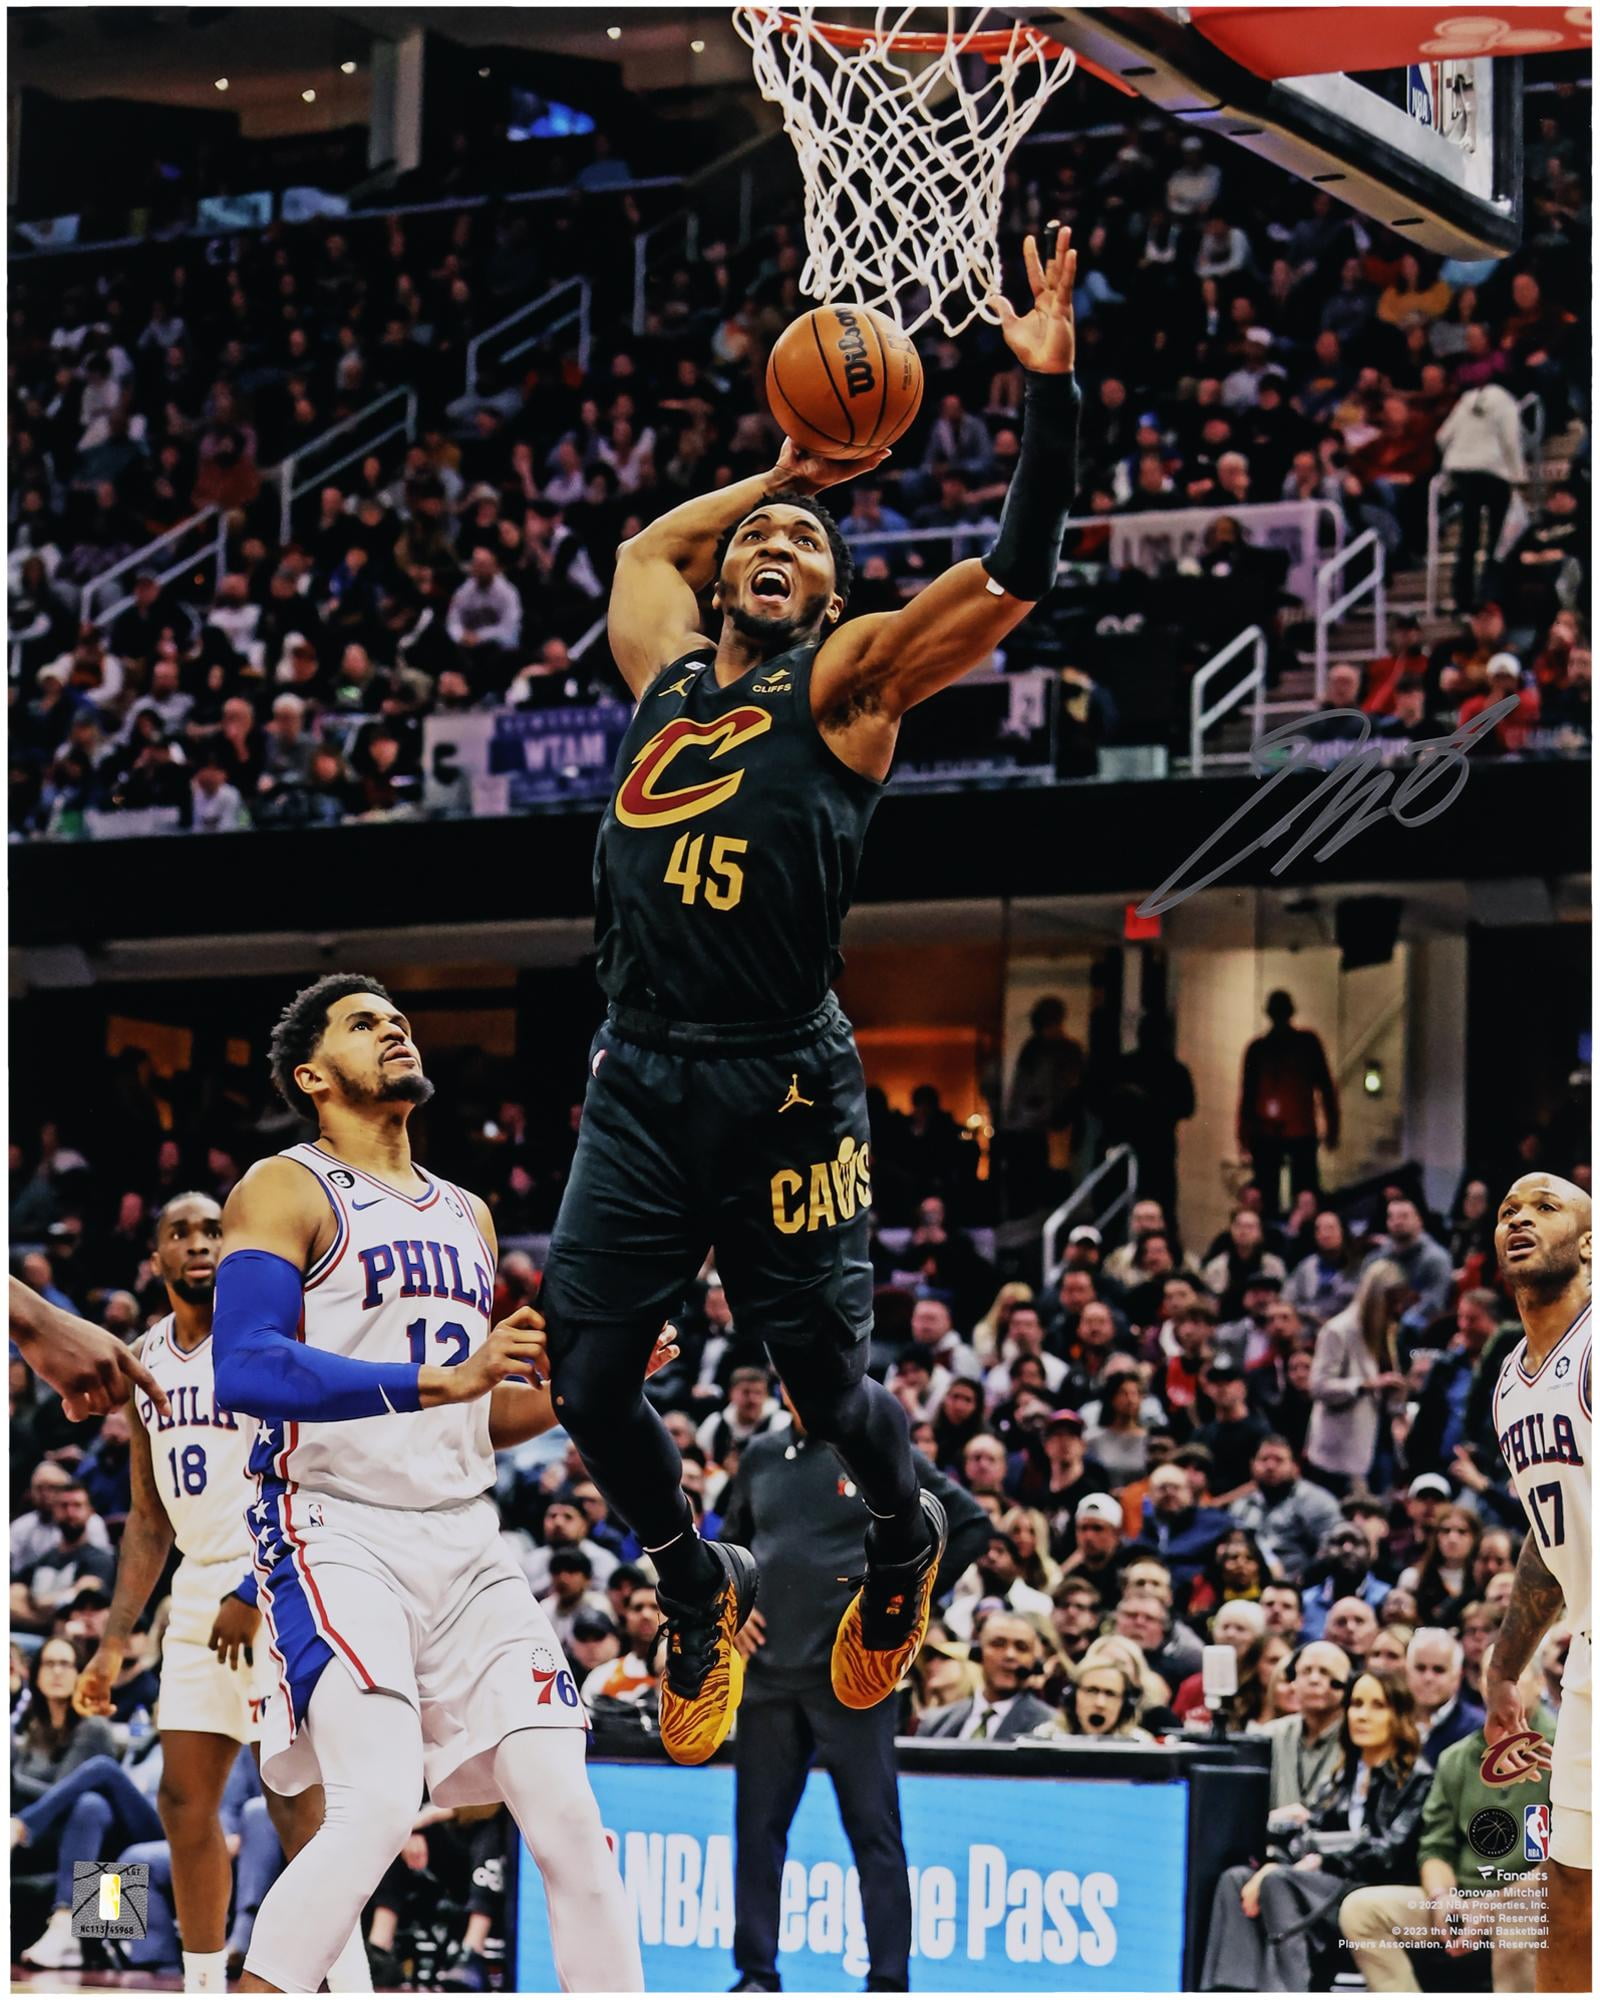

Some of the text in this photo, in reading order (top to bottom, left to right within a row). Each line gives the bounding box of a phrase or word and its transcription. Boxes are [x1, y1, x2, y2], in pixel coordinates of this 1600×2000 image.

[836, 308, 875, 398] Wilson
[752, 683, 792, 694] CLIFFS
[663, 831, 749, 911] 45
[770, 1136, 873, 1234] CAVS
[168, 1443, 208, 1498] 18
[1528, 1481, 1565, 1548] 17
[531, 1667, 579, 1708] 76
[622, 1831, 734, 1949] NBA
[967, 1843, 1119, 1968] Pass
